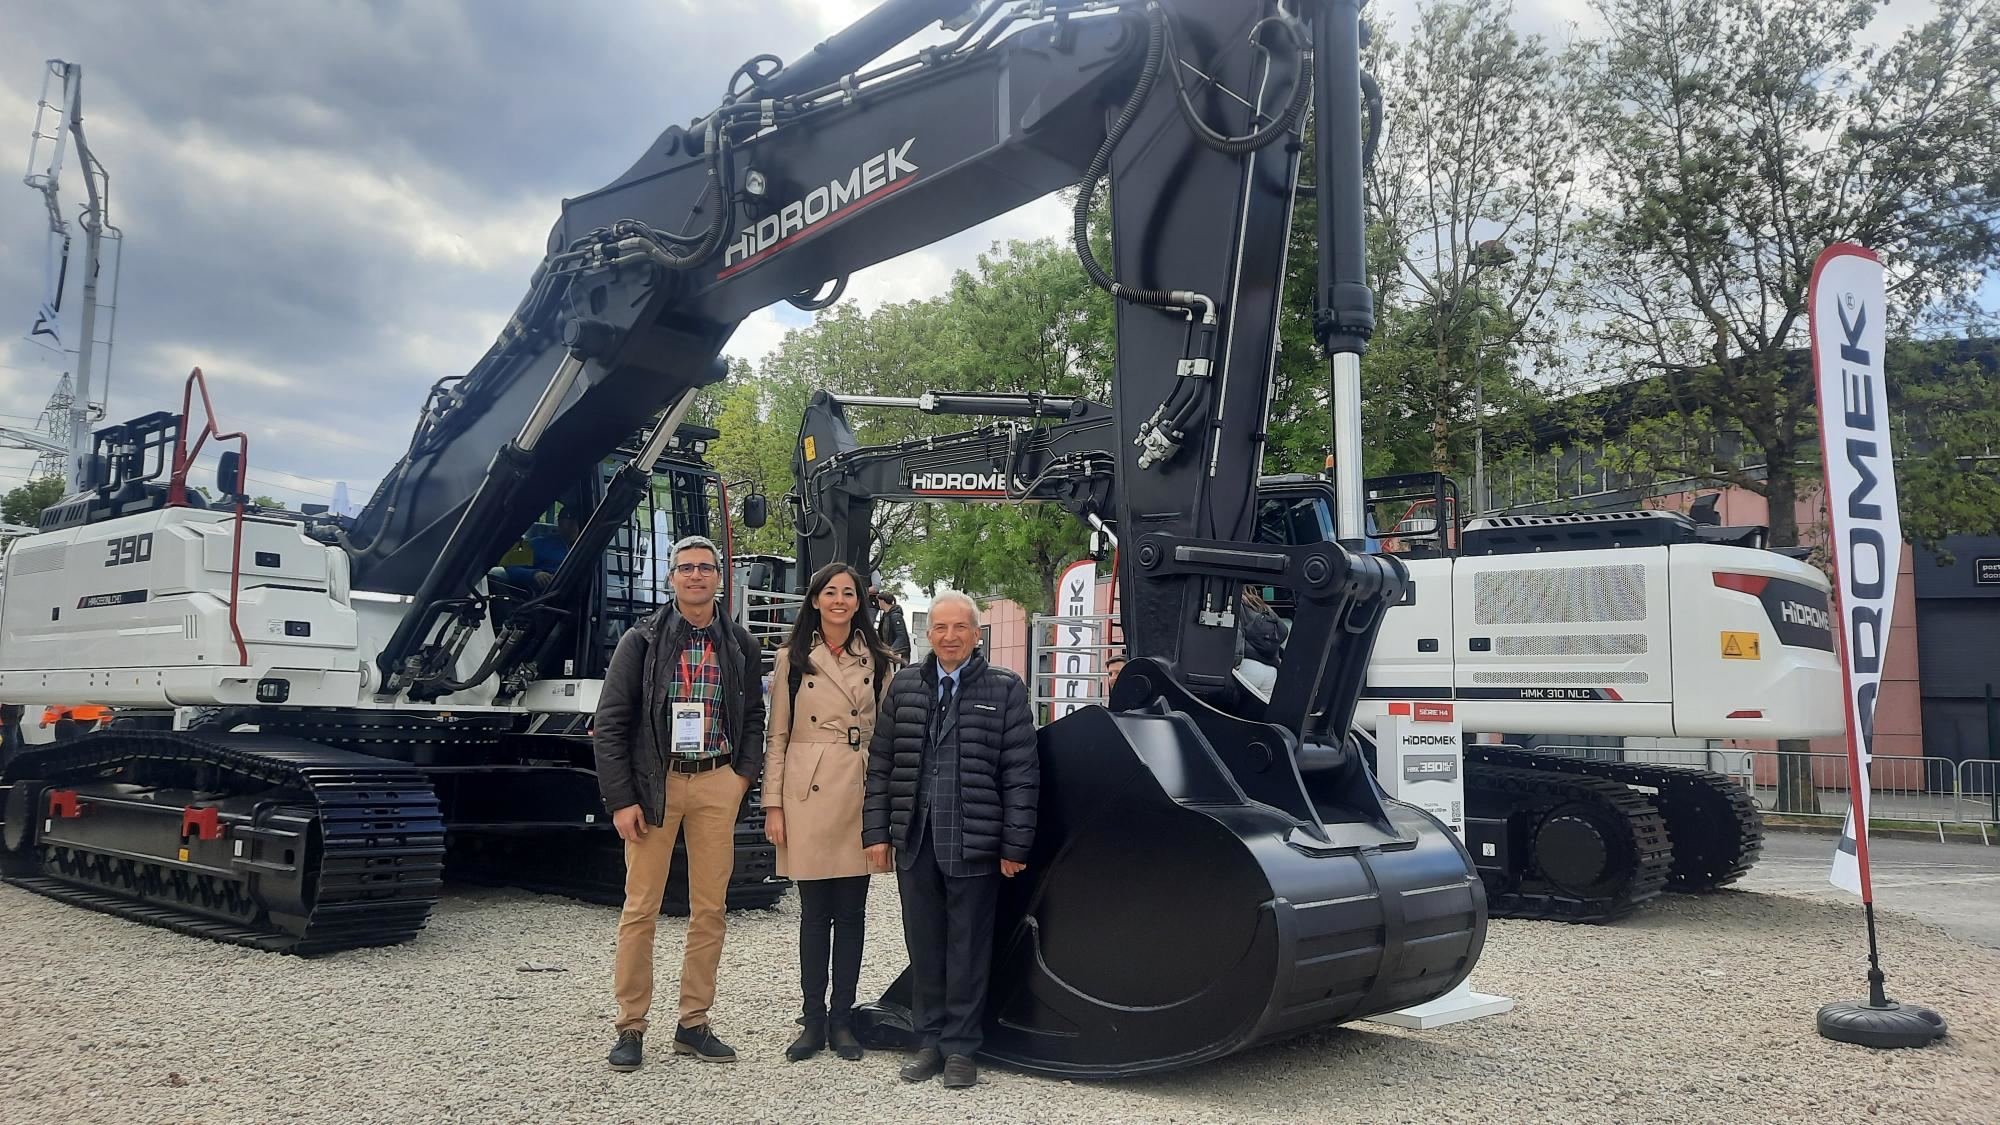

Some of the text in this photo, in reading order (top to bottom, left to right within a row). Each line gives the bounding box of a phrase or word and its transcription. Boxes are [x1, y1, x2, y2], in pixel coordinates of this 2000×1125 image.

[105, 532, 153, 568] 390
[1520, 689, 1590, 698] HMK 310 NLC
[1420, 761, 1443, 772] 390
